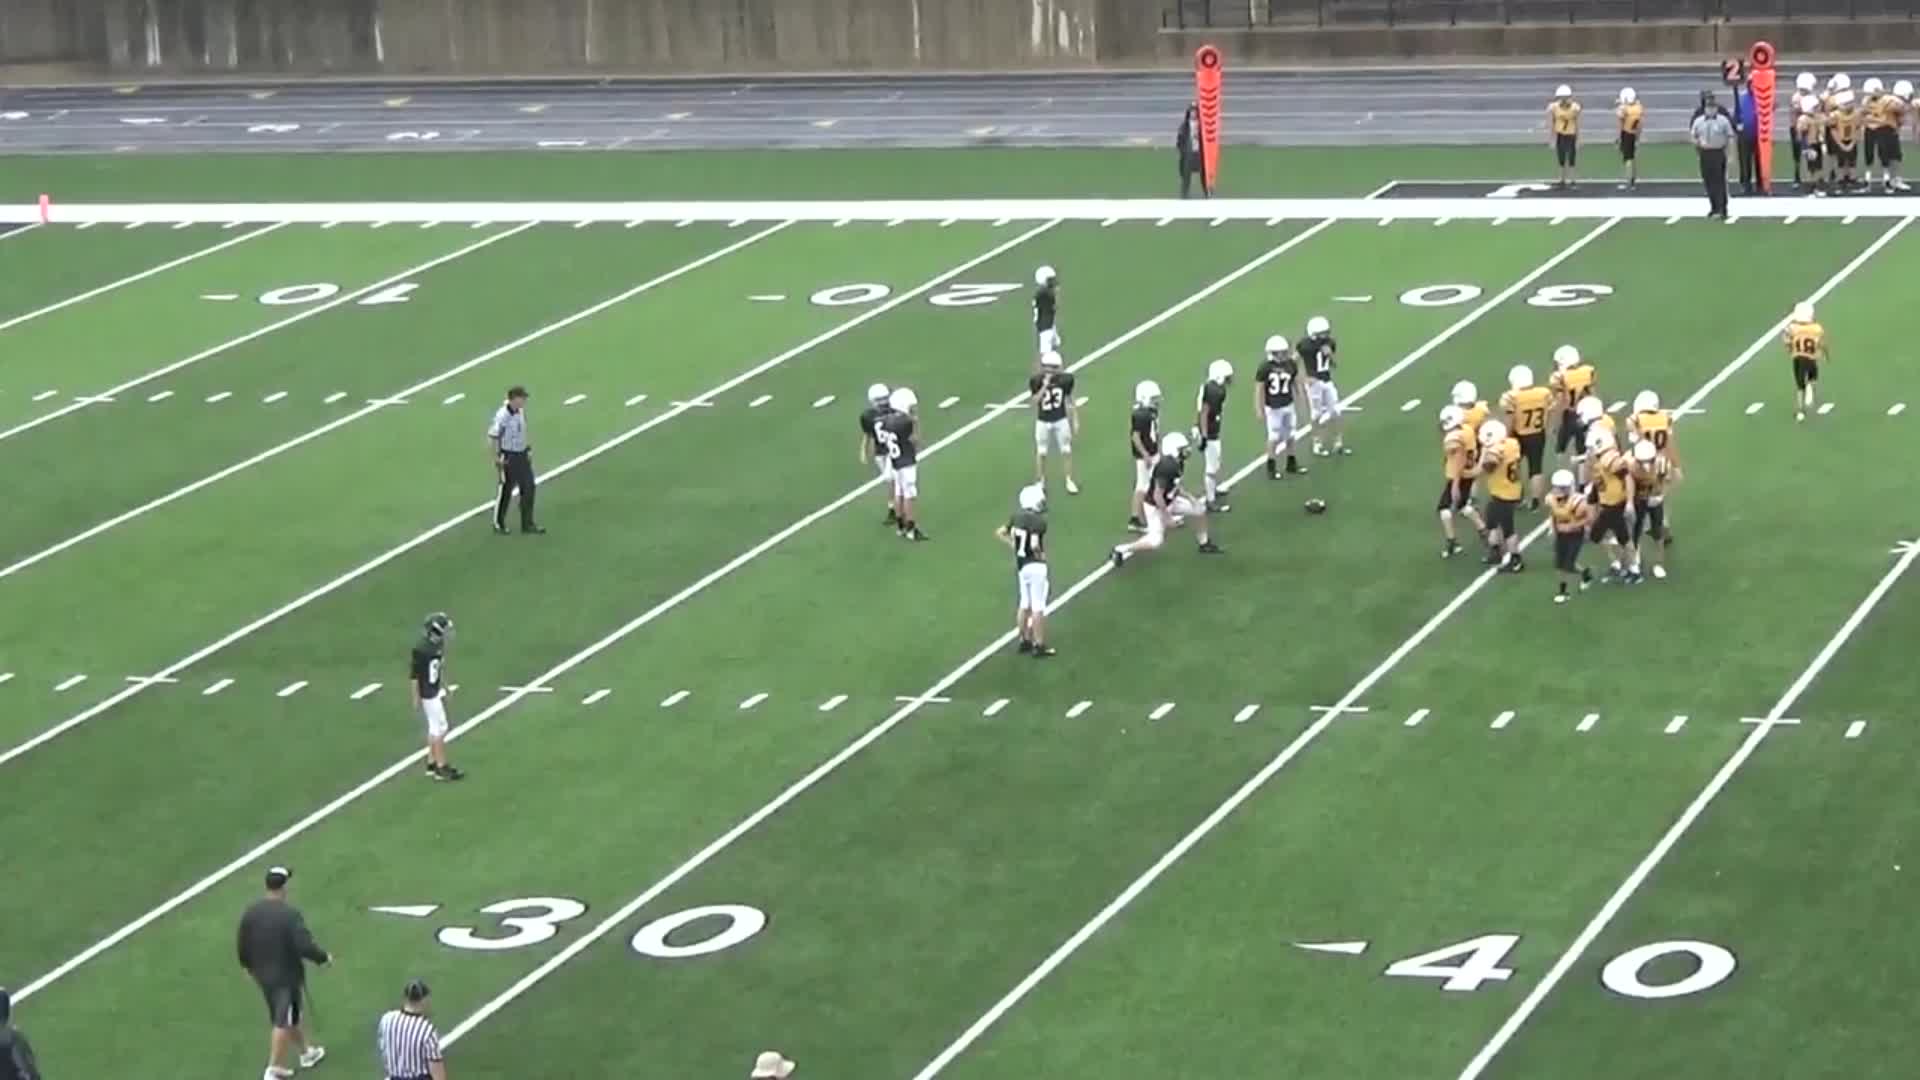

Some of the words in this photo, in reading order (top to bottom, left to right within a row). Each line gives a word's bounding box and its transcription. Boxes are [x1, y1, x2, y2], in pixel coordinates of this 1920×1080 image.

[1726, 60, 1741, 81] 2
[1268, 372, 1291, 395] 37
[1042, 387, 1064, 410] 23
[1522, 407, 1545, 430] 73
[438, 897, 766, 957] 30
[1384, 934, 1737, 998] 40
